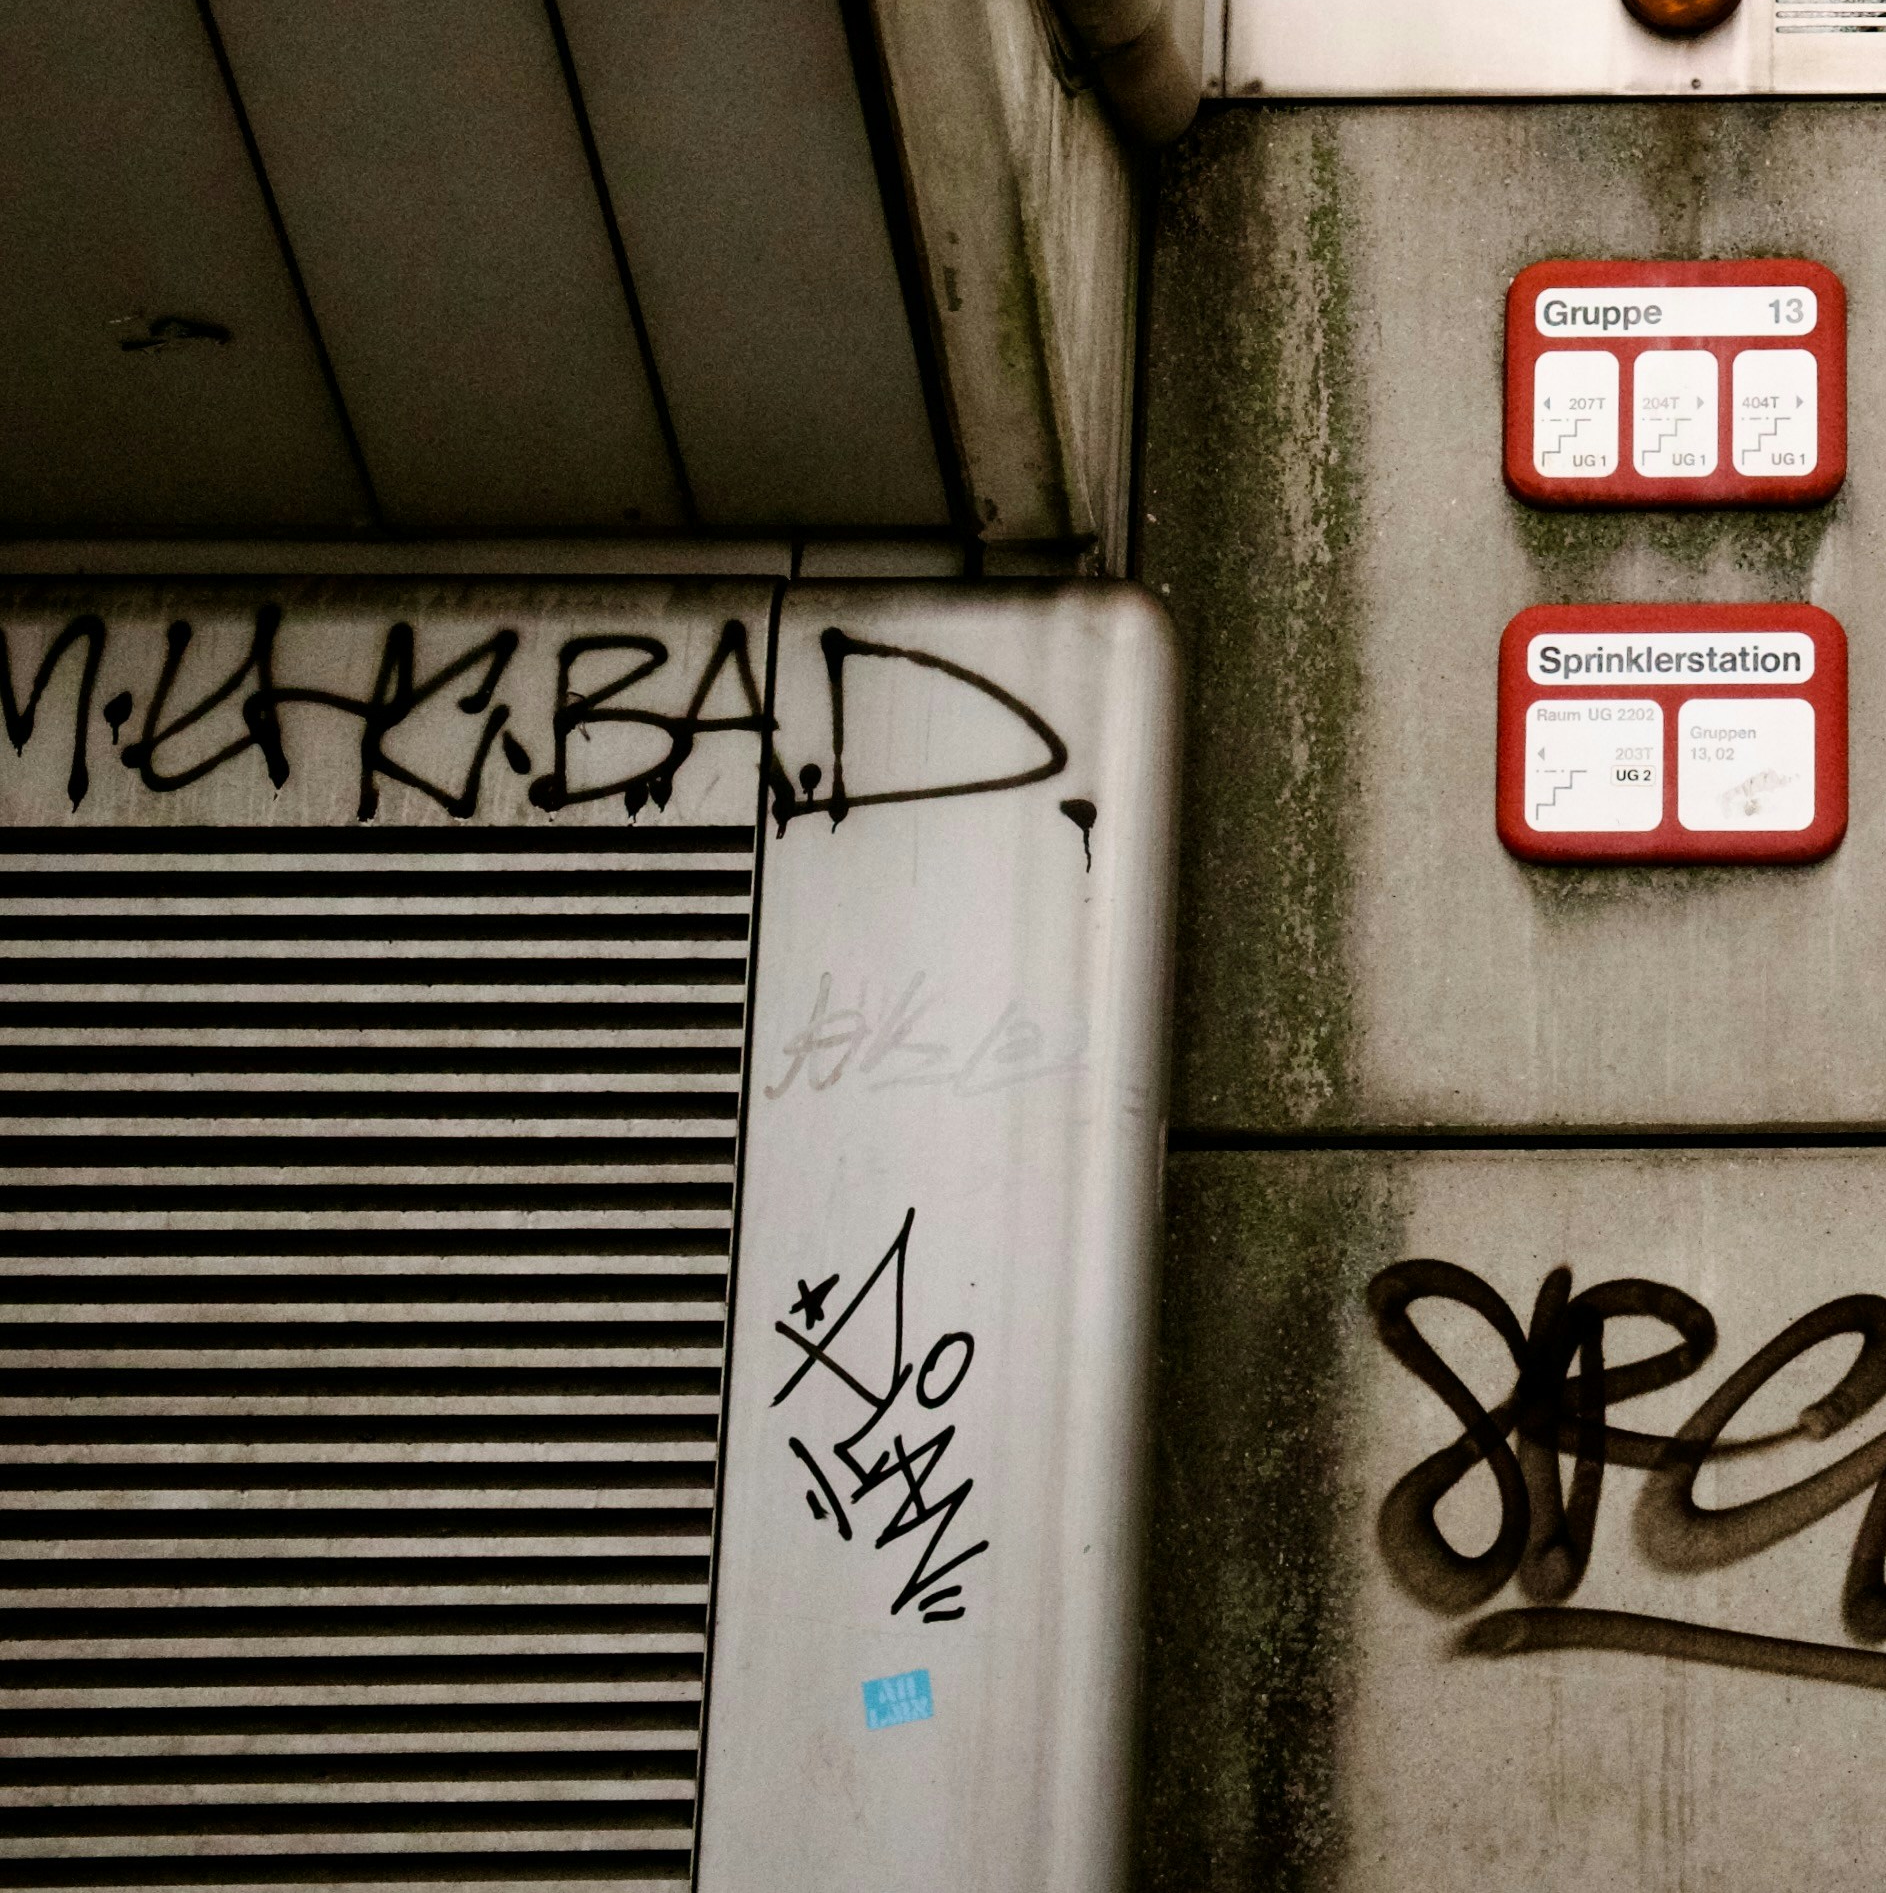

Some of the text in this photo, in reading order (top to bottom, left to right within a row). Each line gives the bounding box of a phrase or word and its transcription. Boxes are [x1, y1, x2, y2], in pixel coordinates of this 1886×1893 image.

[1544, 299, 1803, 330] Gruppe 13
[1569, 398, 1606, 410] 207T
[1643, 397, 1680, 409] 204T
[1742, 396, 1779, 409] 404T
[1573, 455, 1606, 467] UG 1
[1673, 453, 1706, 466] UG 1
[1772, 453, 1805, 466] UG 1
[1540, 646, 1800, 679] Sprinklerstation
[1537, 708, 1654, 721] Raum UG 2202
[1690, 726, 1756, 741] Gruppen
[1616, 747, 1653, 760] 203T
[1716, 748, 1734, 760] 02
[1617, 770, 1651, 781] UG 2
